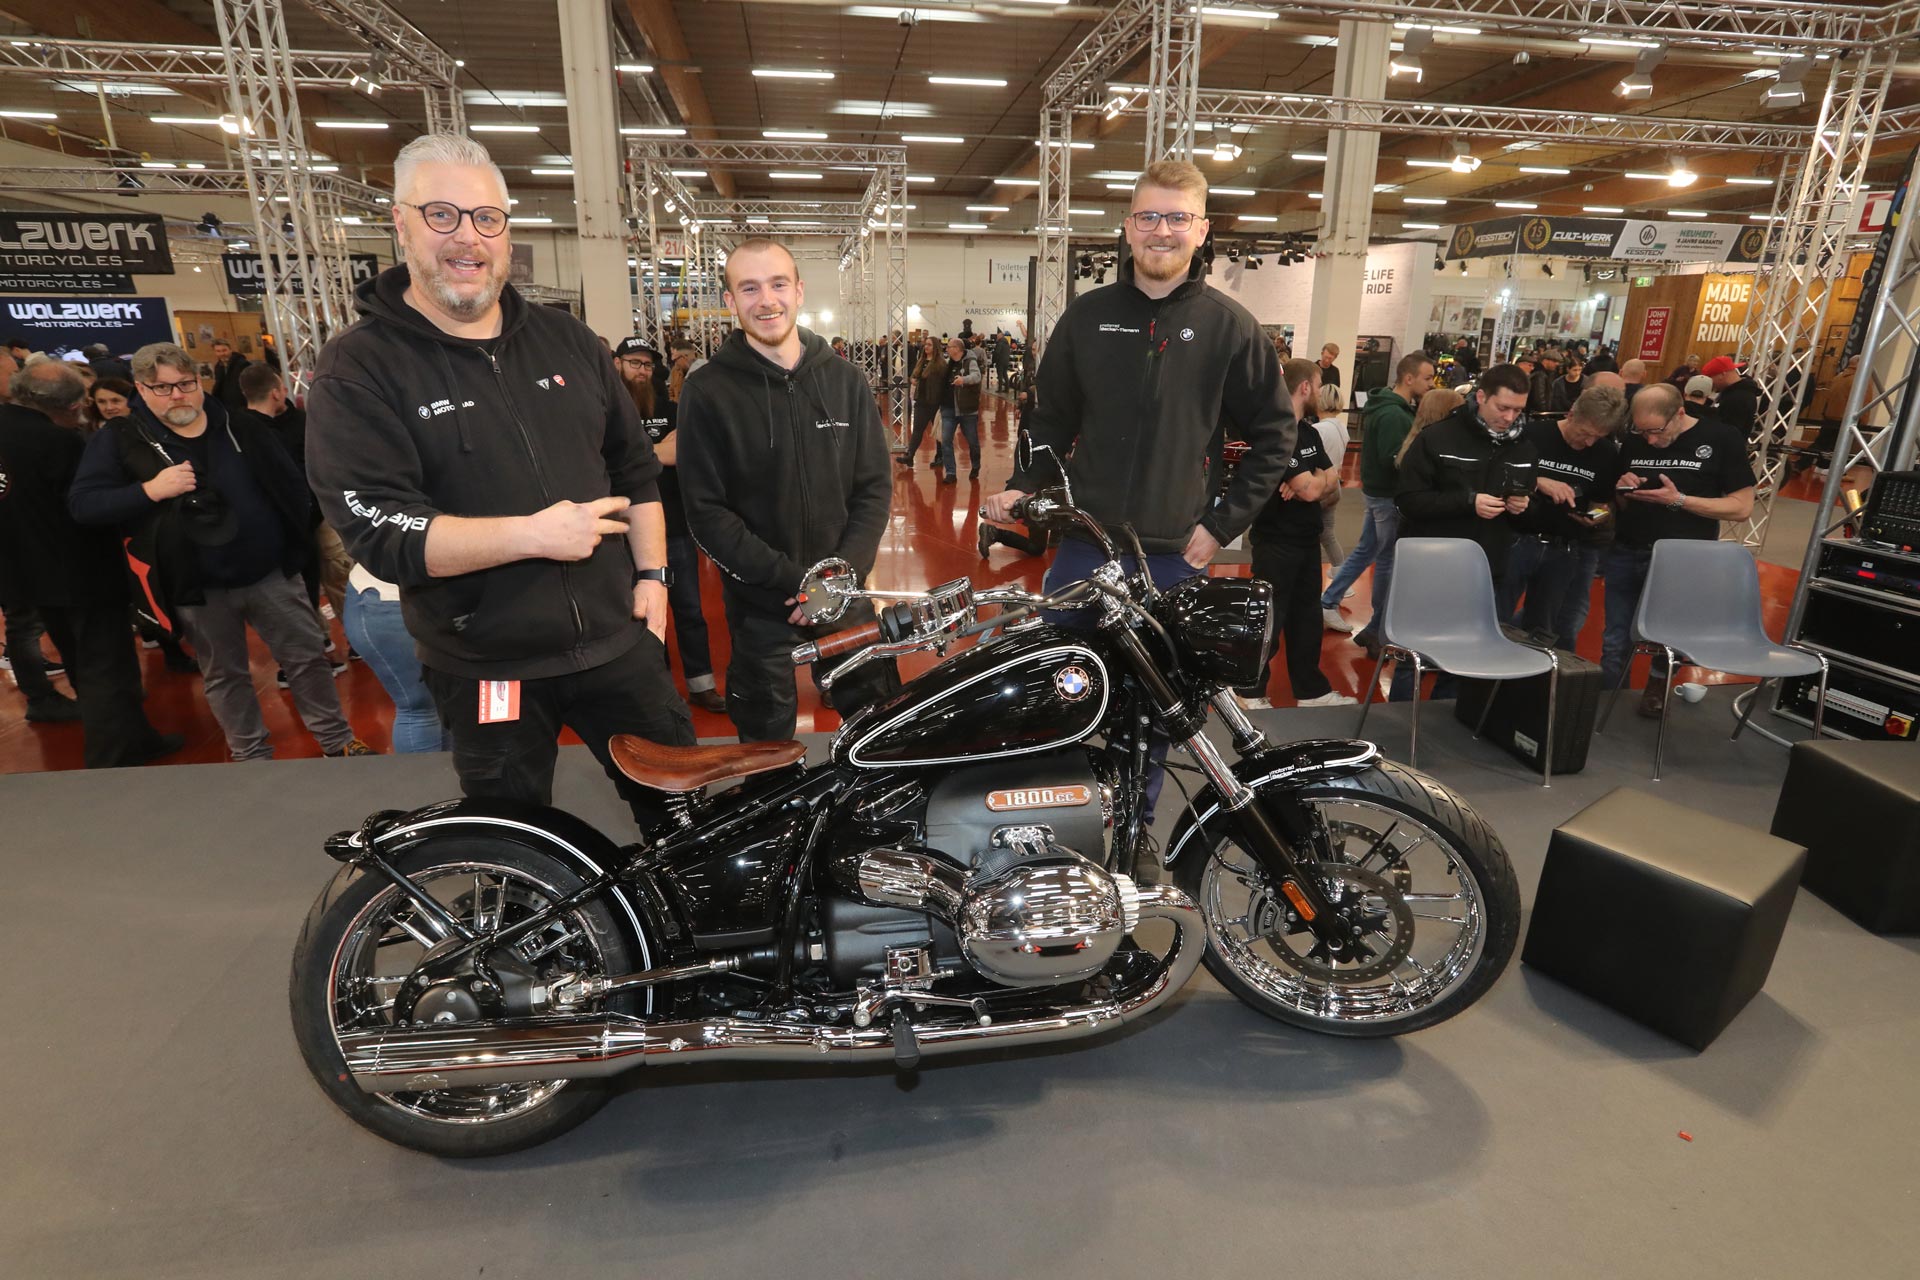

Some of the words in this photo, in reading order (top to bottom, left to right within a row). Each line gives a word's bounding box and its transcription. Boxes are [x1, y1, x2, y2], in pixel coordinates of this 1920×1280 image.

[1552, 231, 1614, 241] CULT-WERK
[1624, 249, 1664, 257] KESSTECH
[1371, 269, 1394, 280] LIFE
[1366, 283, 1393, 294] RIDE
[1706, 283, 1751, 302] MADE
[1701, 303, 1731, 322] FOR
[430, 399, 450, 409] BMW
[433, 400, 475, 415] MOTOAD
[1538, 459, 1555, 467] AKE
[1556, 462, 1573, 471] LIFE
[1580, 468, 1596, 478] RIDE
[1680, 460, 1702, 468] RIDE
